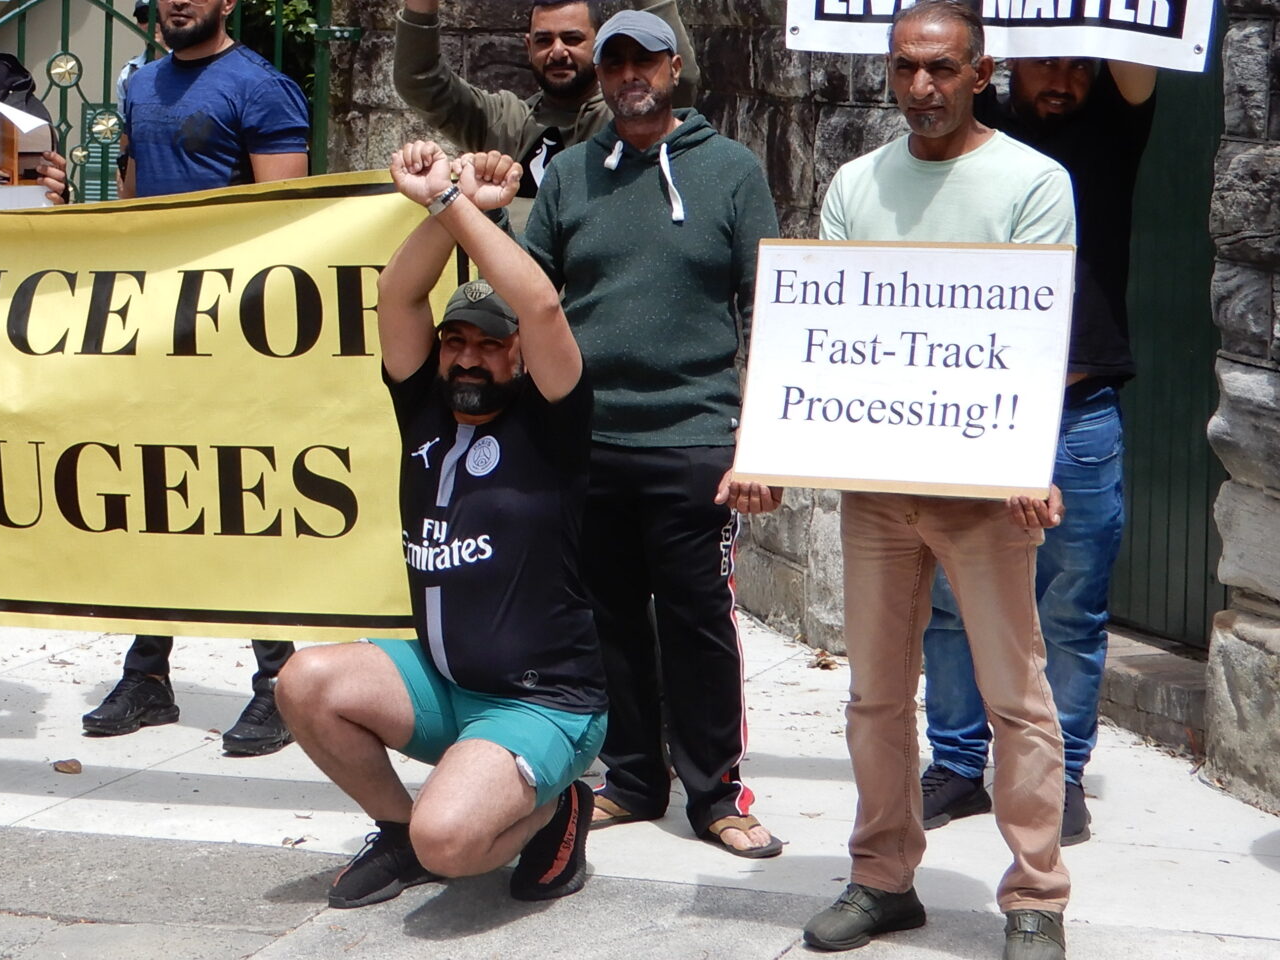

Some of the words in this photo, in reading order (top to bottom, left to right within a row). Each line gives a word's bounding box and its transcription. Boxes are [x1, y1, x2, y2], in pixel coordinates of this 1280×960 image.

[771, 269, 846, 306] End
[860, 271, 1055, 312] Inhumane
[801, 328, 1010, 370] Fast-Track
[777, 385, 1020, 439] Processing!!
